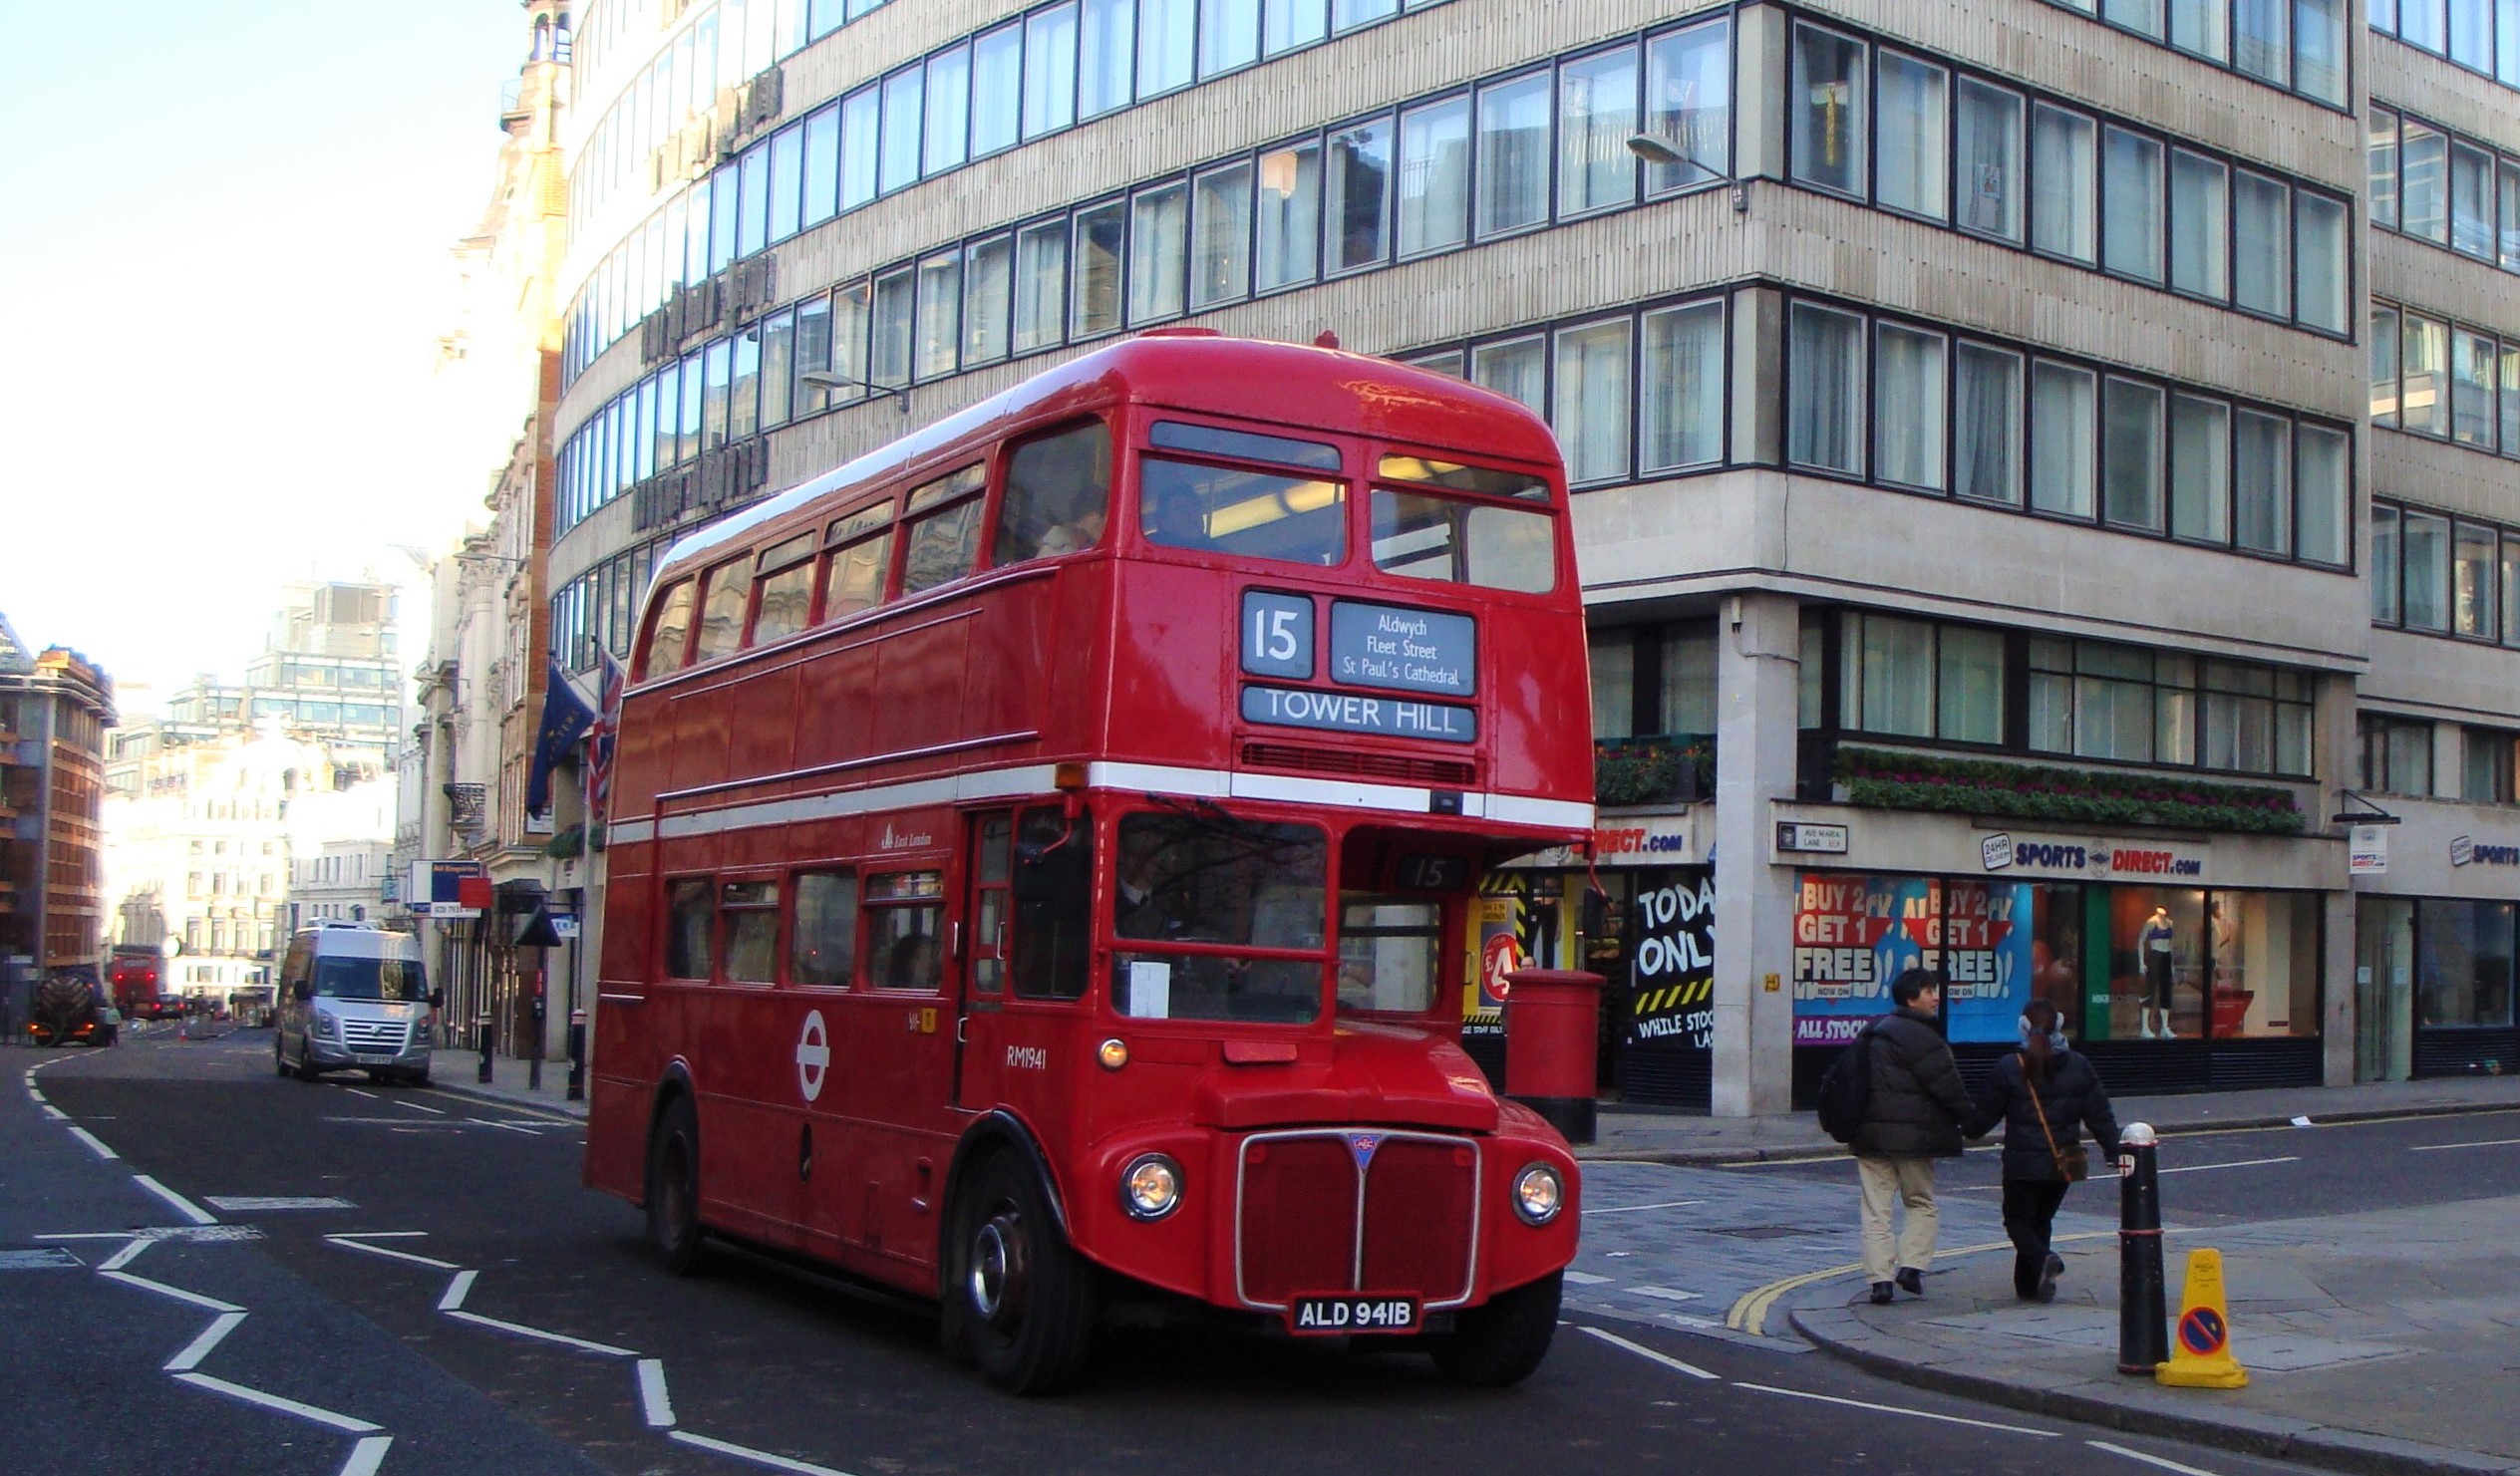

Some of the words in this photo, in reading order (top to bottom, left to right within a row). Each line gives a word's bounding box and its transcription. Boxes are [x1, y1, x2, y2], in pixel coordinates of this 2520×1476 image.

[1255, 609, 1299, 661] 15
[1379, 614, 1427, 639] Aldwych
[1367, 636, 1398, 656] Fleet
[1403, 639, 1437, 660] Street
[1344, 656, 1357, 675] St
[1362, 660, 1400, 679] Paul's
[1405, 663, 1460, 686] Cathedral
[1265, 689, 1381, 726] TOWER
[1397, 704, 1458, 734] HILL
[1985, 839, 2008, 854] 24HR
[2016, 842, 2086, 868] SPORTS
[1415, 860, 1447, 887] 15
[1638, 876, 1716, 929] TODA
[1803, 882, 1849, 912] BUY
[1853, 886, 1865, 912] 2
[1975, 890, 1987, 915] 2
[1798, 914, 1849, 943] GET
[1856, 916, 1867, 943] 1
[1979, 920, 1989, 946] 1
[1639, 925, 1715, 976] ONL
[1794, 948, 1873, 981] FREE
[1817, 987, 1835, 996] NOW
[1838, 987, 1850, 996] ON
[1638, 1015, 1683, 1038] WHILE
[1687, 1010, 1714, 1032] STOC
[1797, 1020, 1823, 1038] ALL
[1006, 1044, 1047, 1069] RM1941
[1299, 1302, 1350, 1326] ALD
[1356, 1302, 1412, 1326] 941B
